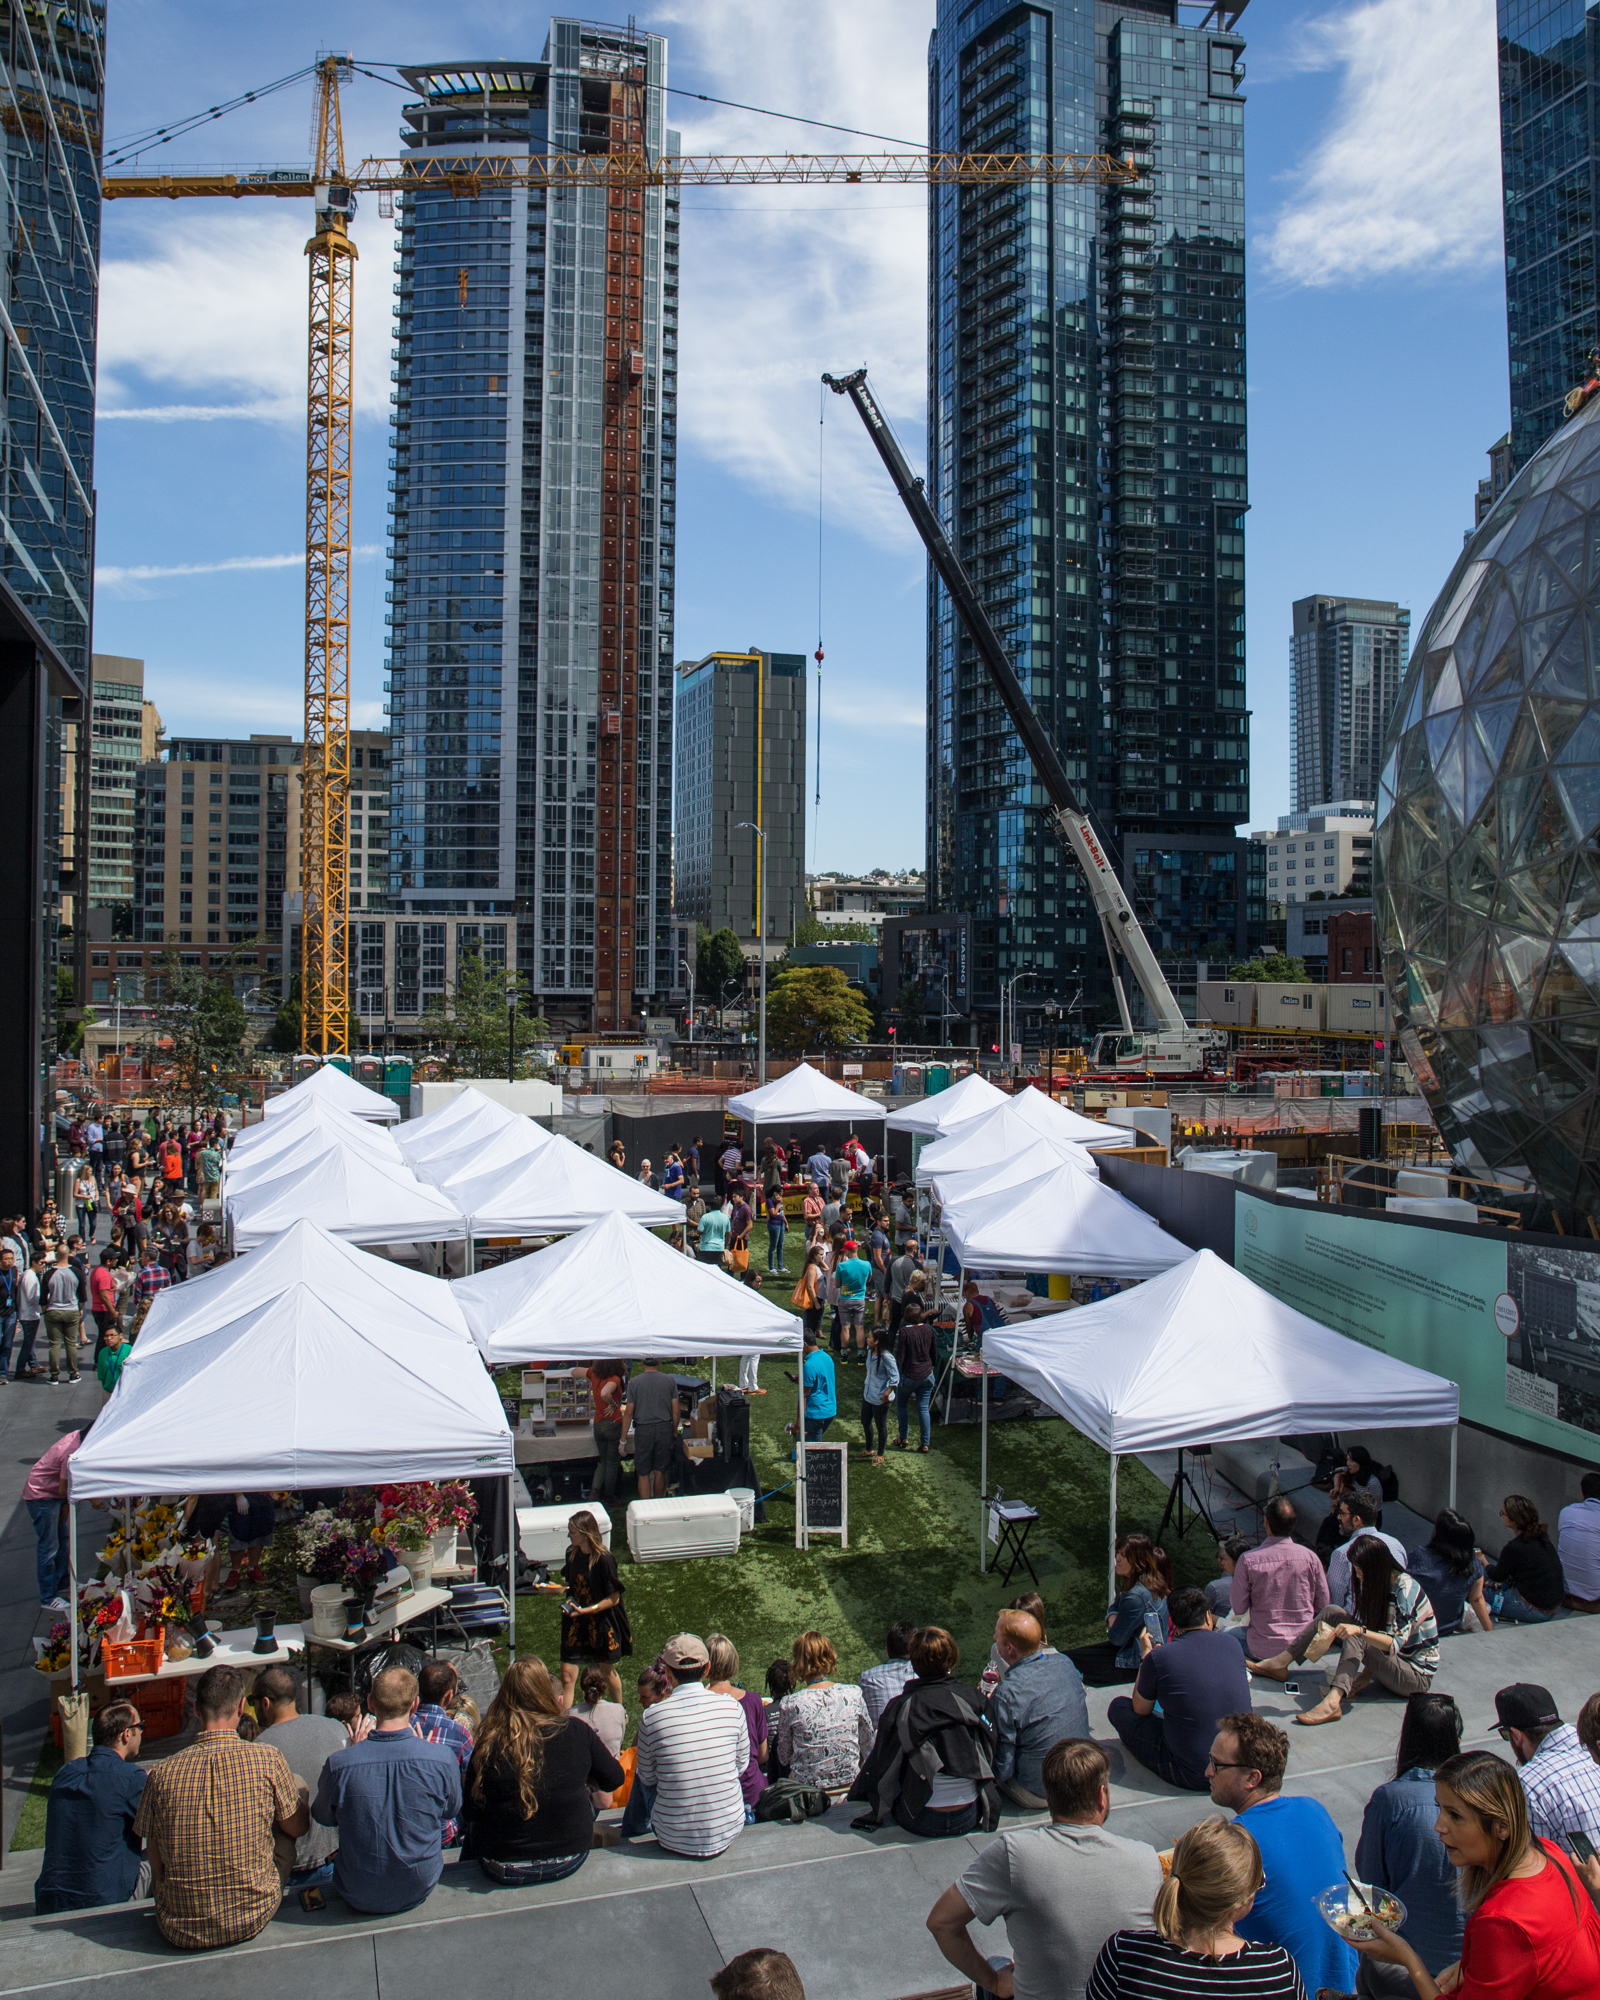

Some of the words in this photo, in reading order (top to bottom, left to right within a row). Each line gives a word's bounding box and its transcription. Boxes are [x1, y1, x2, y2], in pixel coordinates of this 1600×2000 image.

[276, 173, 307, 181] Sellen
[856, 386, 883, 428] Link-Belt
[1080, 825, 1105, 868] Link-Belt
[806, 1452, 830, 1462] SWEET
